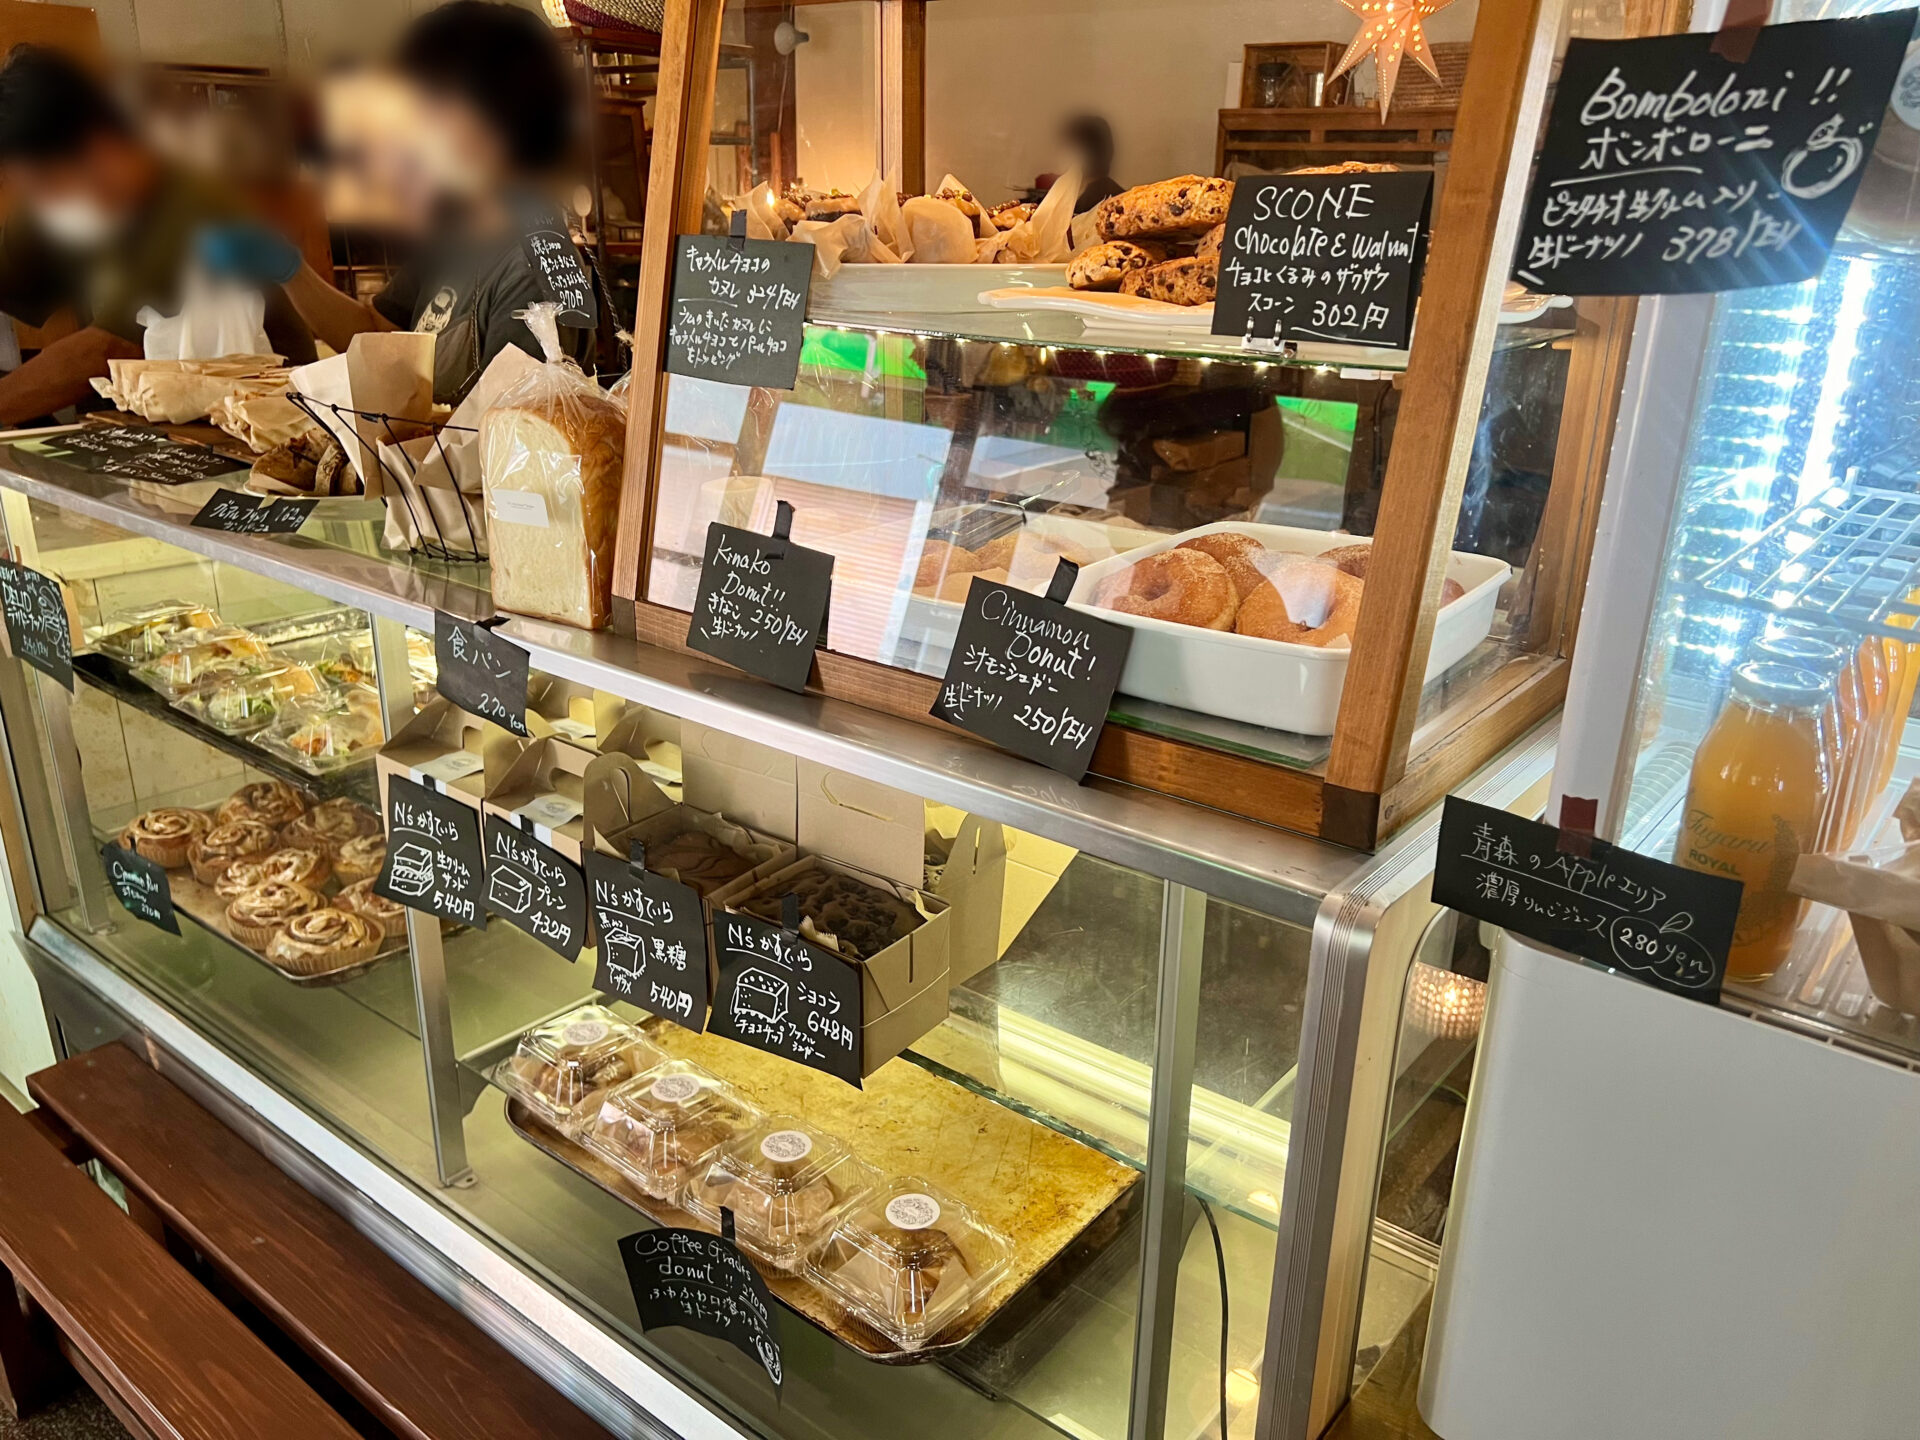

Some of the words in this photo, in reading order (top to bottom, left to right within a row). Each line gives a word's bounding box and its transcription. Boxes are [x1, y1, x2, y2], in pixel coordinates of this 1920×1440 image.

[1580, 66, 1794, 126] Bomboloni
[1579, 125, 1773, 170] ボンボローニ
[1253, 183, 1375, 222] SCONE
[709, 276, 741, 298] カヌレ
[1248, 293, 1295, 314] スコーン
[1312, 300, 1389, 330] 302円
[712, 534, 771, 575] Kinako
[981, 590, 1090, 650] Cinnamon
[447, 626, 511, 678] 食パン
[963, 644, 1058, 695] シナモンシュガー
[394, 801, 413, 826] N's
[496, 832, 519, 860] N's
[1689, 849, 1741, 876] ROYAL
[436, 850, 470, 878] 生クリーム
[442, 872, 468, 891] サンド
[537, 885, 567, 910] プレーン
[595, 879, 618, 906] N's
[433, 890, 475, 921] 540円
[530, 911, 571, 946] 432円
[728, 923, 754, 949] N's
[650, 936, 687, 971] 黒糖
[650, 980, 693, 1018] 540円
[797, 981, 841, 1015] ショコラ
[736, 1018, 785, 1045] チョコチップ
[808, 1010, 853, 1051] 648円
[635, 1233, 704, 1256] Coffee
